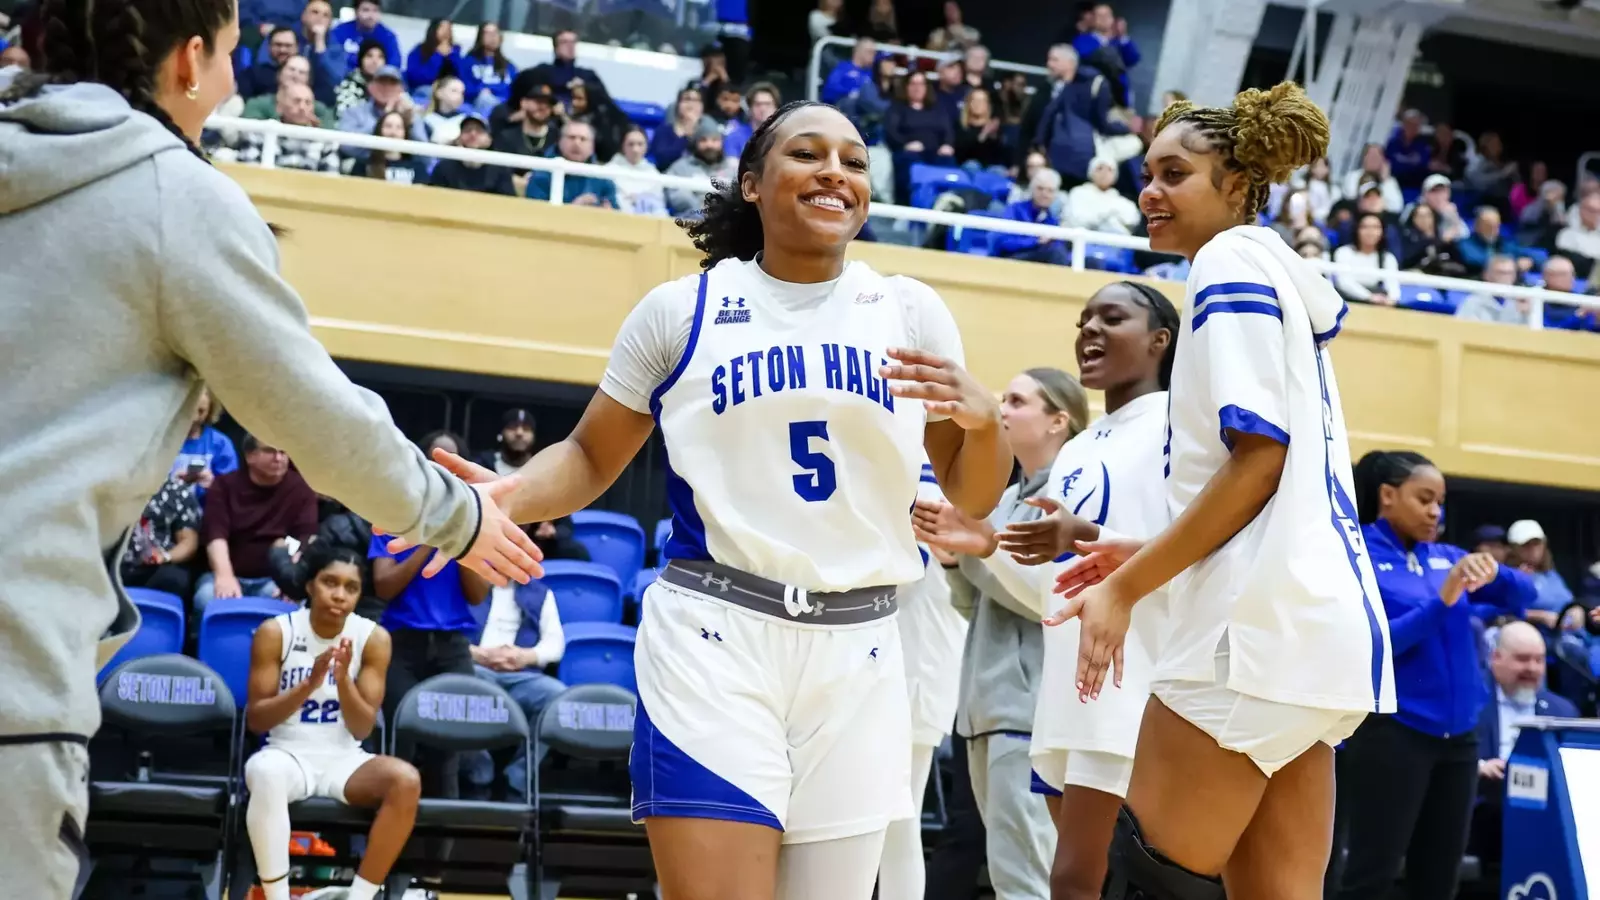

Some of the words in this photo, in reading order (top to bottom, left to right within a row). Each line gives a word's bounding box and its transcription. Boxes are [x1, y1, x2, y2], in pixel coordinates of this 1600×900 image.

[714, 315, 752, 325] CHANGE
[711, 345, 806, 415] SETON
[821, 343, 894, 414] HALL
[789, 420, 837, 502] 5
[118, 672, 170, 702] SETON
[171, 675, 216, 704] HALL
[300, 699, 340, 723] 22
